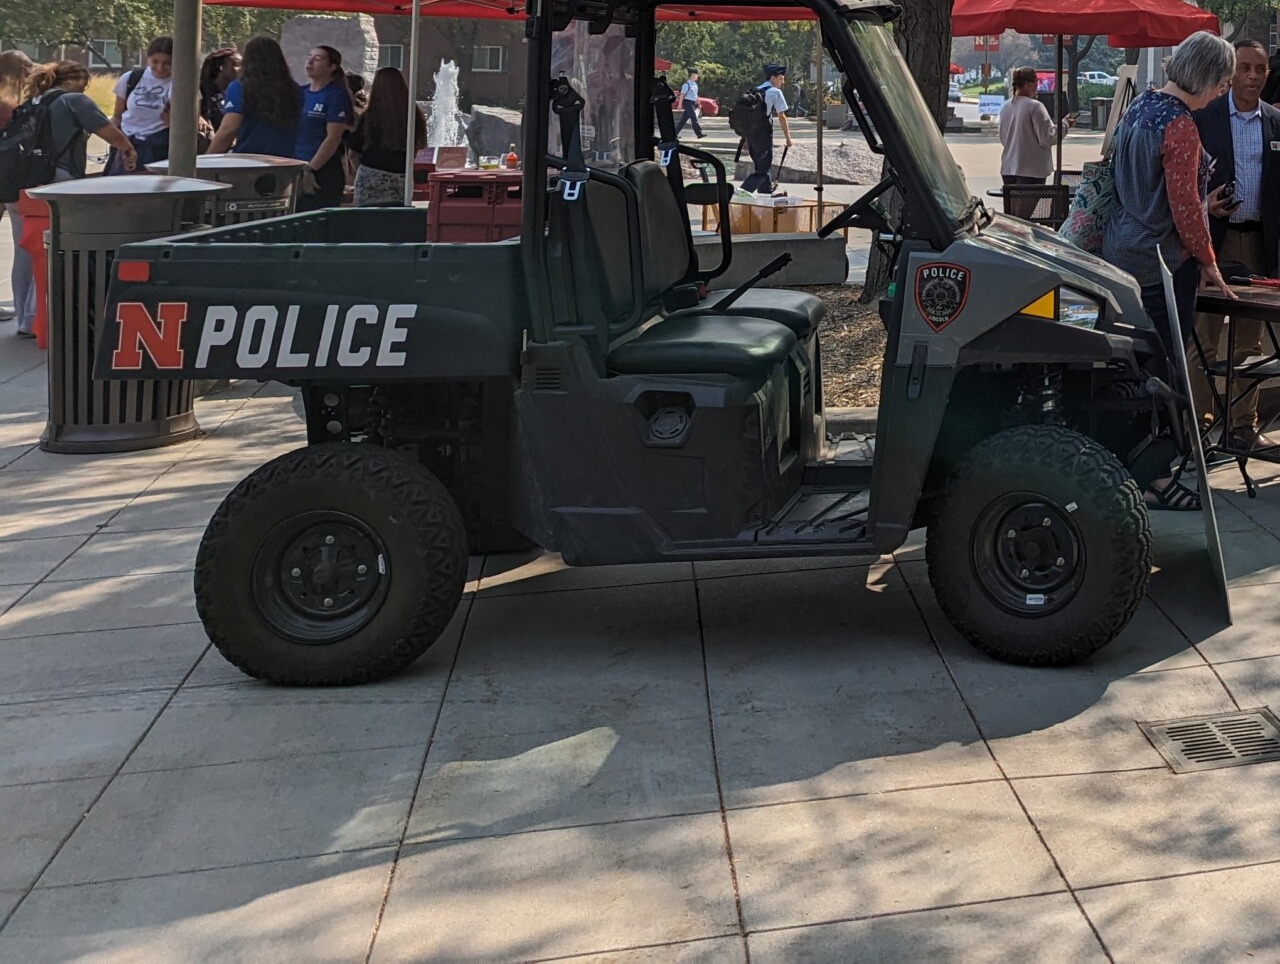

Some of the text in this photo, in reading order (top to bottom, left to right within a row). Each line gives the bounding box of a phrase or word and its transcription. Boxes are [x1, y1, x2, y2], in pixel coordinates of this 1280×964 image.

[923, 267, 965, 281] POLICE
[112, 302, 418, 370] N POLICE
